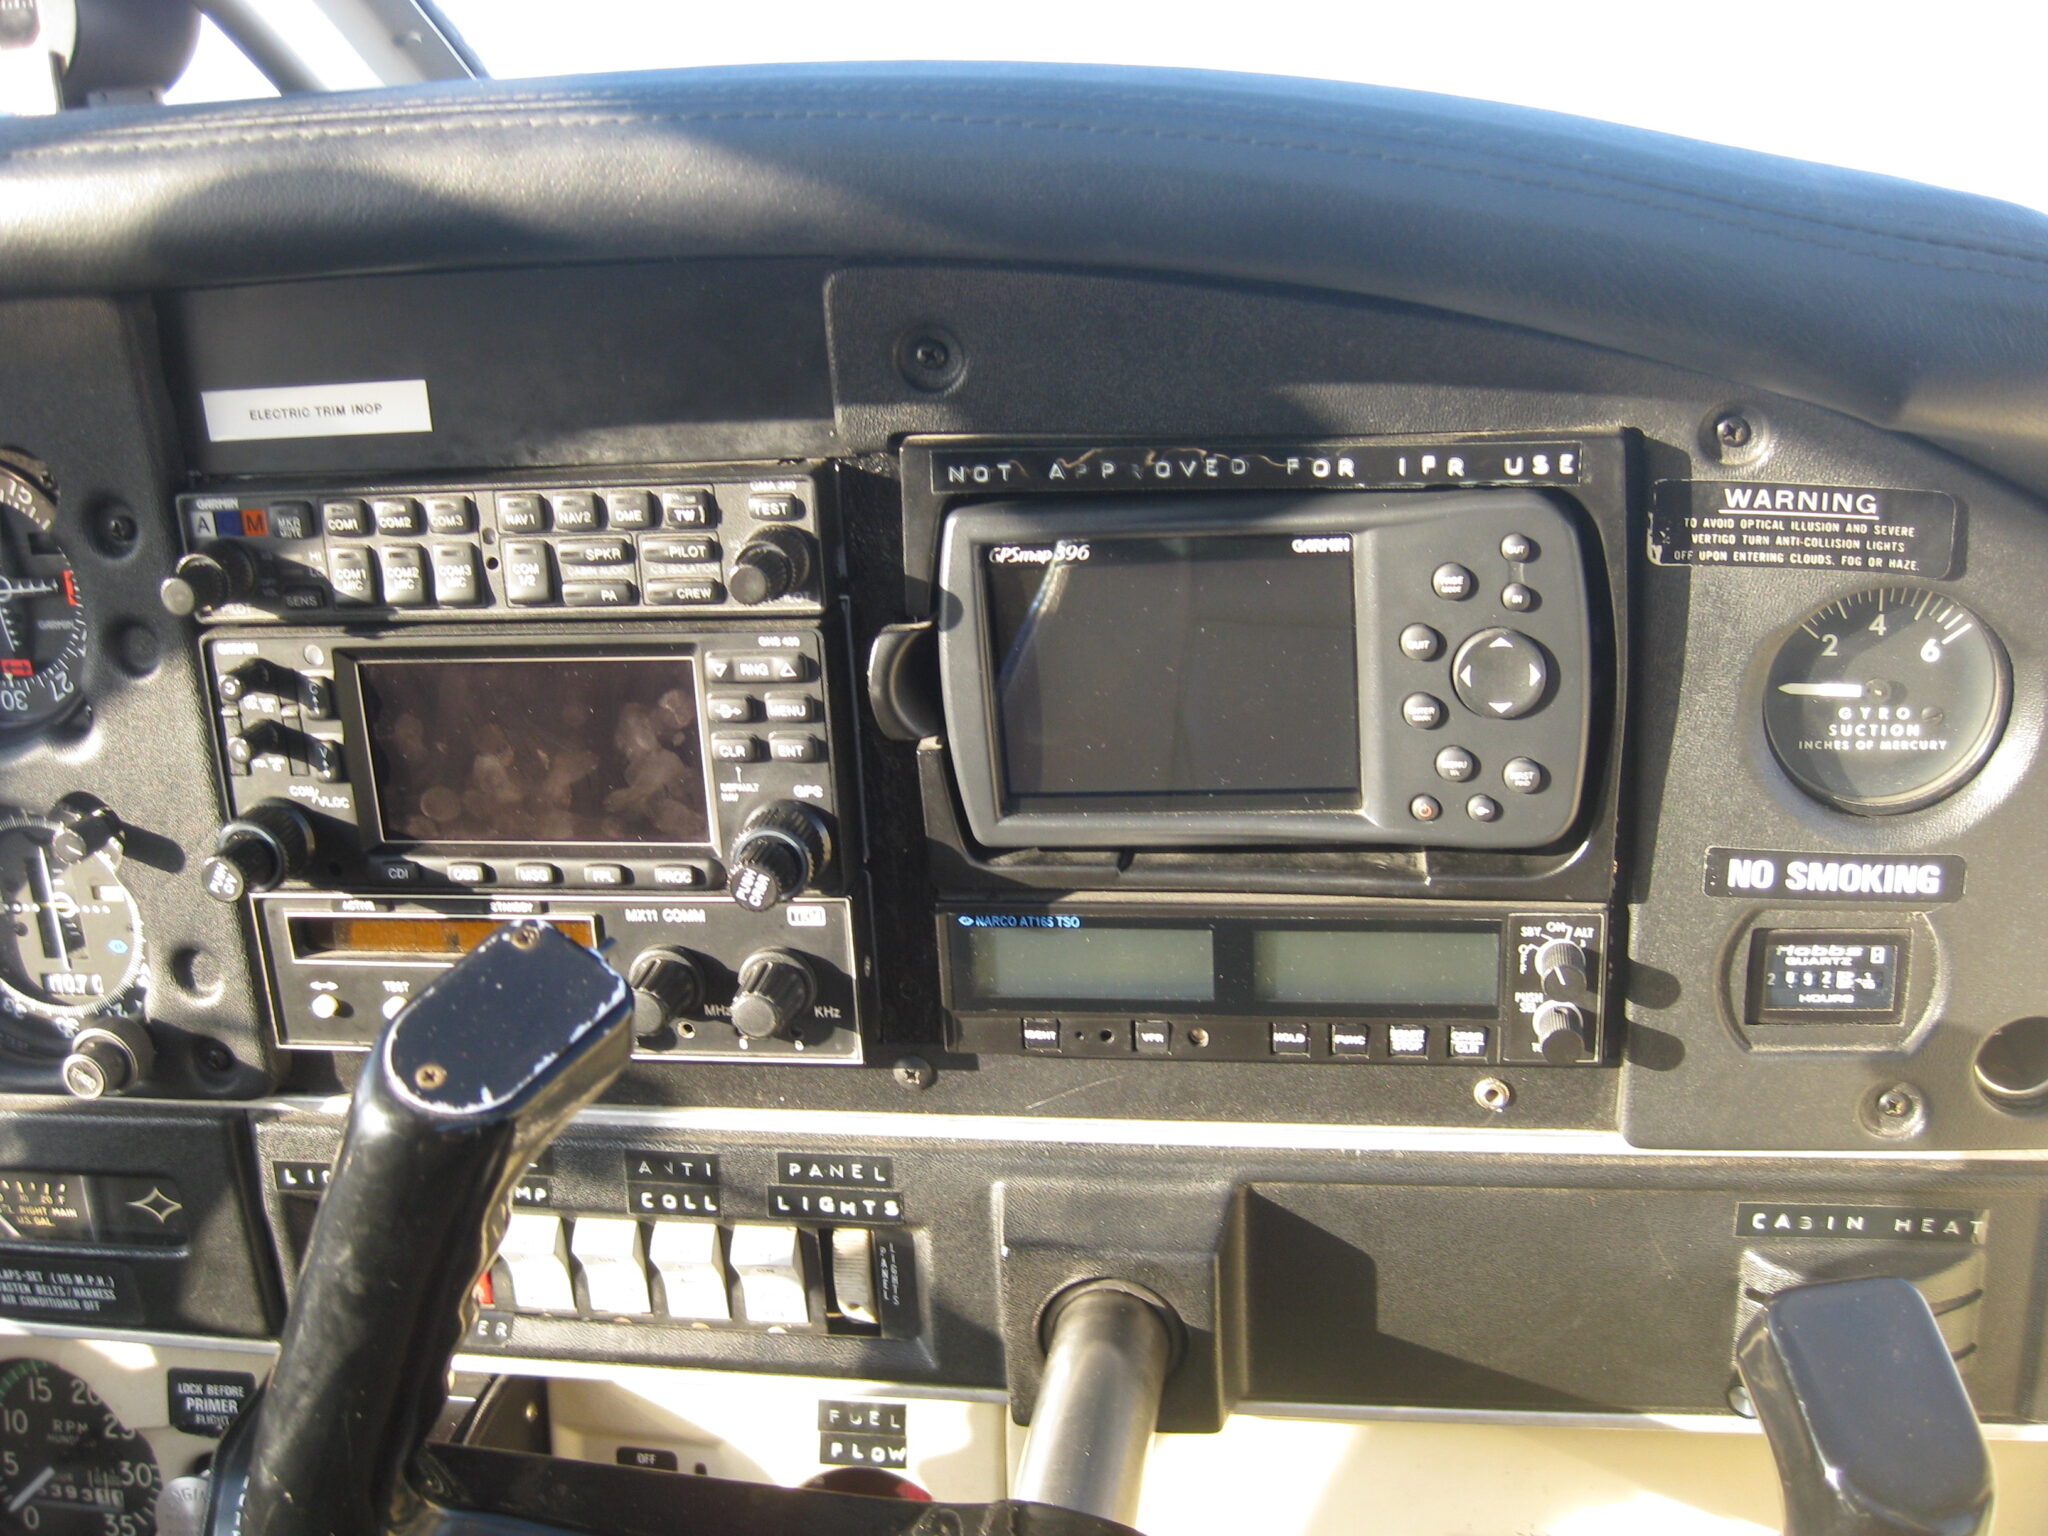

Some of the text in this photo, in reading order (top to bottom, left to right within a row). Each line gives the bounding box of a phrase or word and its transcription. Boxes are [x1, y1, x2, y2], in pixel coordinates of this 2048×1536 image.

[248, 402, 383, 421] ELECTRIC TRIM INOP
[948, 464, 1011, 483] NOT
[1049, 457, 1247, 480] APPROVED
[1286, 457, 1355, 478] FOR
[1504, 453, 1574, 476] USE
[1724, 488, 1878, 514] WARNING
[614, 509, 643, 522] DME
[755, 502, 788, 516] TEST
[198, 517, 211, 533] A
[246, 515, 264, 532] M
[379, 516, 413, 529] COM2
[430, 514, 464, 528] COM3
[505, 513, 535, 526] NAV1
[559, 510, 592, 524] NAV2
[327, 518, 359, 531] COM1
[1684, 517, 1916, 538] TO AVOID OPTICAL ILLUSION AND SEVERE
[1292, 538, 1350, 553] GARMIN
[1691, 533, 1905, 553] VERTIGO TURN ANTI-COLLISION LIGHTS
[309, 551, 323, 563] HI
[584, 548, 622, 562] SPKR
[668, 546, 707, 559] PILOT
[1053, 544, 1090, 561] 396
[1674, 550, 1693, 561] OFF
[1698, 550, 1728, 562] UPON
[1732, 551, 1784, 564] ENTERING
[1840, 554, 1862, 567] FOG
[1867, 556, 1883, 568] OR
[1888, 558, 1920, 572] HAZE.
[335, 568, 367, 580] COM1
[387, 566, 420, 580] COM2
[439, 564, 473, 577] COM3
[511, 563, 540, 576] COM
[601, 589, 618, 602] PA
[676, 587, 712, 600] CREW
[286, 595, 318, 608] SENS
[1869, 614, 1886, 636] 4
[1821, 634, 1838, 656] 2
[1920, 638, 1941, 663] 6
[739, 663, 769, 676] RNG
[768, 705, 806, 717] MENU
[1838, 706, 1911, 721] GYRO
[1828, 723, 1920, 737] SUCTION
[719, 745, 746, 758] CLR
[777, 744, 804, 757] ENT
[1799, 739, 1948, 751] INCHES OF MERCURY
[793, 785, 824, 798] GPS
[388, 868, 409, 880] CDI
[453, 868, 479, 881] OBS
[520, 869, 548, 883] MSG
[592, 870, 614, 883] FPL
[658, 869, 692, 884] PROC
[1727, 858, 1942, 894] NO SMOKING
[735, 867, 757, 902] PUSH
[662, 909, 706, 923] COMM
[975, 915, 1018, 927] NARCO
[1056, 916, 1080, 928] TSO
[1520, 926, 1542, 937] SBY
[1546, 921, 1566, 933] ON
[1574, 927, 1595, 939] ALT
[382, 980, 410, 993] TEST
[1799, 994, 1854, 1003] HOURS
[814, 1005, 841, 1019] KHz
[638, 1161, 712, 1177] ANTI
[788, 1162, 886, 1182] PANEL
[514, 1187, 547, 1201] MP
[640, 1192, 718, 1212] COLL
[777, 1196, 900, 1217] LIGHTS
[51, 1207, 78, 1218] MAIN
[1894, 1217, 1989, 1236] HEAT
[0, 1268, 43, 1283] LAPS-SET
[879, 1245, 890, 1301] PANEL
[888, 1241, 900, 1307] LIGHTS
[0, 1281, 32, 1295] ASTEN
[20, 1295, 81, 1310] CONDITIONER
[82, 1299, 101, 1311] OFF
[28, 1376, 53, 1402] 15
[178, 1382, 245, 1398] LOCK BEFORE
[186, 1397, 239, 1414] PRIMER
[2, 1409, 29, 1434] 10
[52, 1418, 89, 1434] RPM
[195, 1414, 231, 1426] FLIGHT
[829, 1409, 900, 1429] FUEL
[4, 1453, 19, 1476] 5
[637, 1453, 657, 1465] OFF
[120, 1461, 153, 1488] 30
[23, 1505, 40, 1530] 0
[104, 1513, 138, 1536] 35
